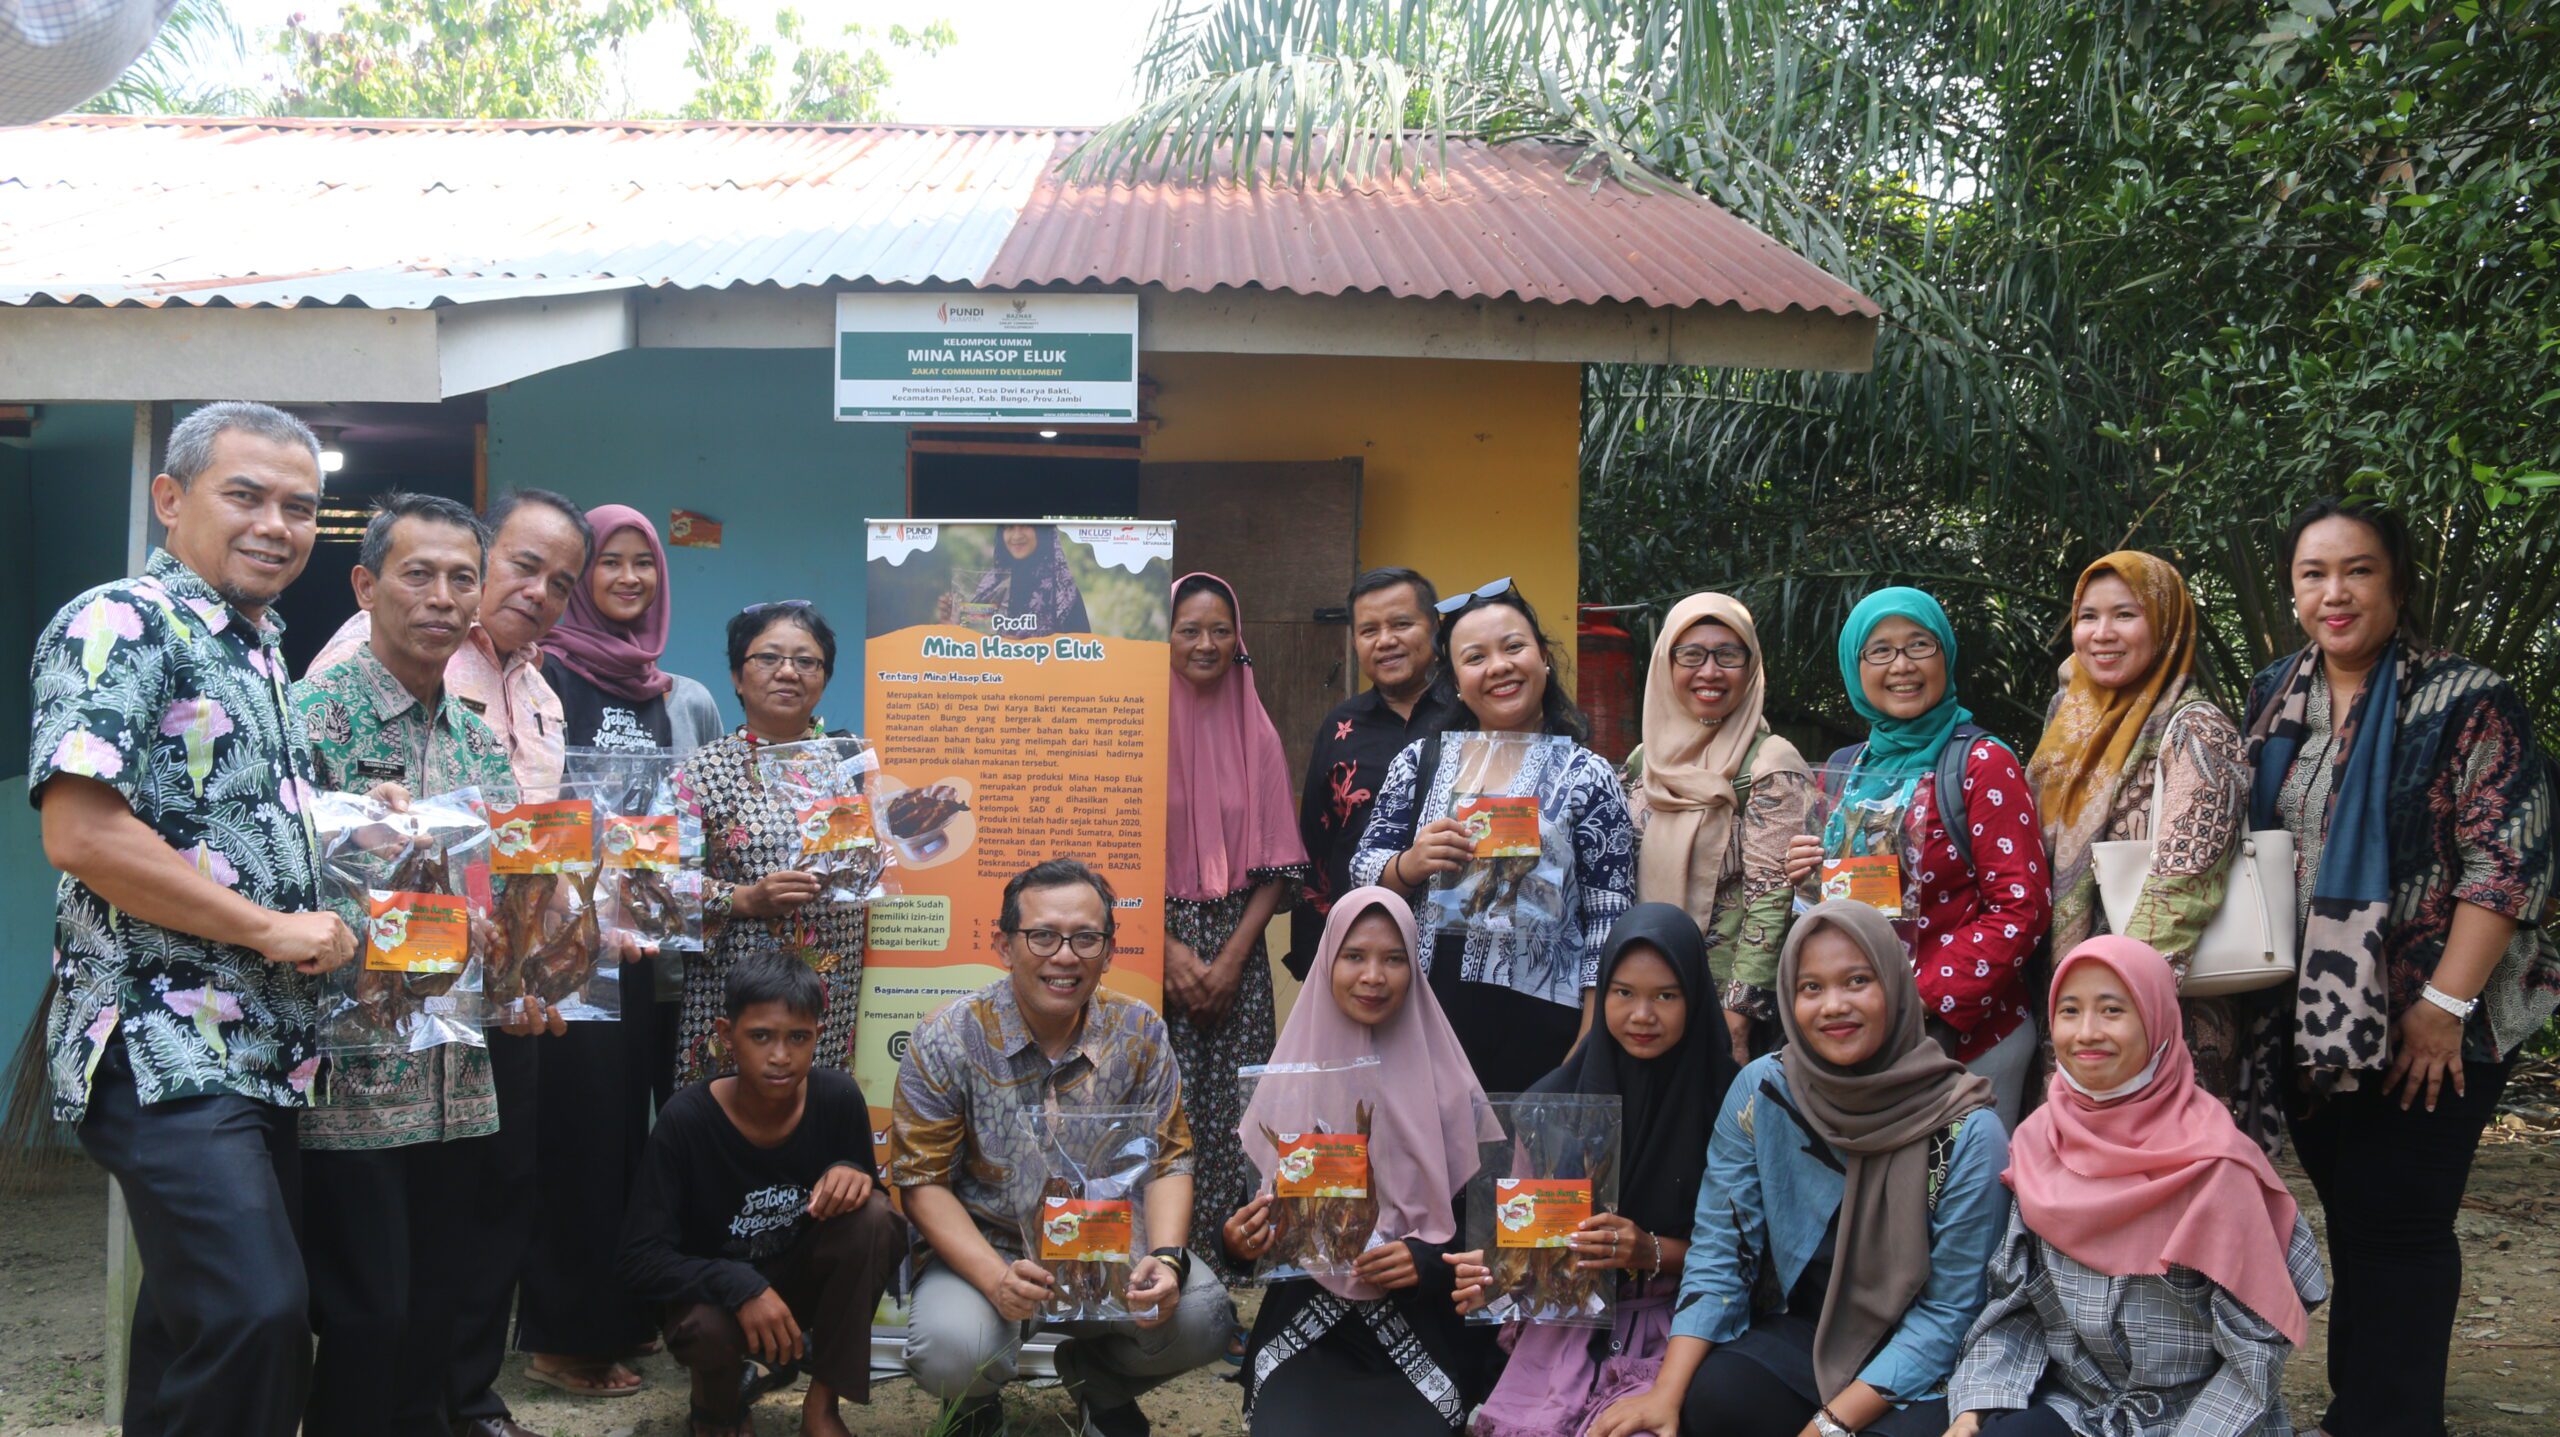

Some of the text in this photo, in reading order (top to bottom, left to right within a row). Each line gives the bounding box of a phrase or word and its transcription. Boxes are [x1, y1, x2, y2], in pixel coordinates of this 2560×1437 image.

[944, 338, 997, 346] KELOMPOK
[908, 350, 1066, 362] MINA HASOP ELUK
[993, 615, 1036, 630] Profil
[923, 637, 1103, 662] Mina Hasop Eluk
[879, 673, 1002, 683] Tentang Mina Hasop Eluk
[937, 692, 978, 701] kelompok
[1049, 695, 1095, 703] perempuan
[917, 702, 939, 711] (SAD)
[1005, 704, 1028, 713] Karya
[1113, 707, 1144, 715] Pelepat
[602, 706, 637, 730] Setara
[886, 713, 930, 721] Kabupaten
[940, 714, 966, 723] Bungo
[1005, 716, 1041, 724] bergerak
[964, 726, 994, 734] dengan
[593, 729, 656, 751] Keberagaman
[976, 736, 995, 744] baku
[974, 747, 1016, 755] komunitas
[1047, 750, 1097, 758] menginisiasi
[1107, 750, 1143, 759] hadirnya
[885, 757, 917, 765] gagasan
[920, 758, 950, 766] produk
[1094, 775, 1119, 783] Hasop
[980, 783, 1026, 791] merupakan
[1033, 784, 1062, 792] produk
[979, 806, 1019, 814] kelompok
[1073, 807, 1106, 815] Propinsi
[979, 838, 1025, 846] Peternakan
[1097, 840, 1141, 848] Kabupaten
[1108, 862, 1141, 870] BAZNAS
[978, 870, 1020, 878] Kabupate
[871, 938, 902, 947] sebagai
[874, 986, 918, 995] Bagaimana
[865, 1011, 914, 1019] Pemesanan
[742, 1187, 798, 1215] Setara
